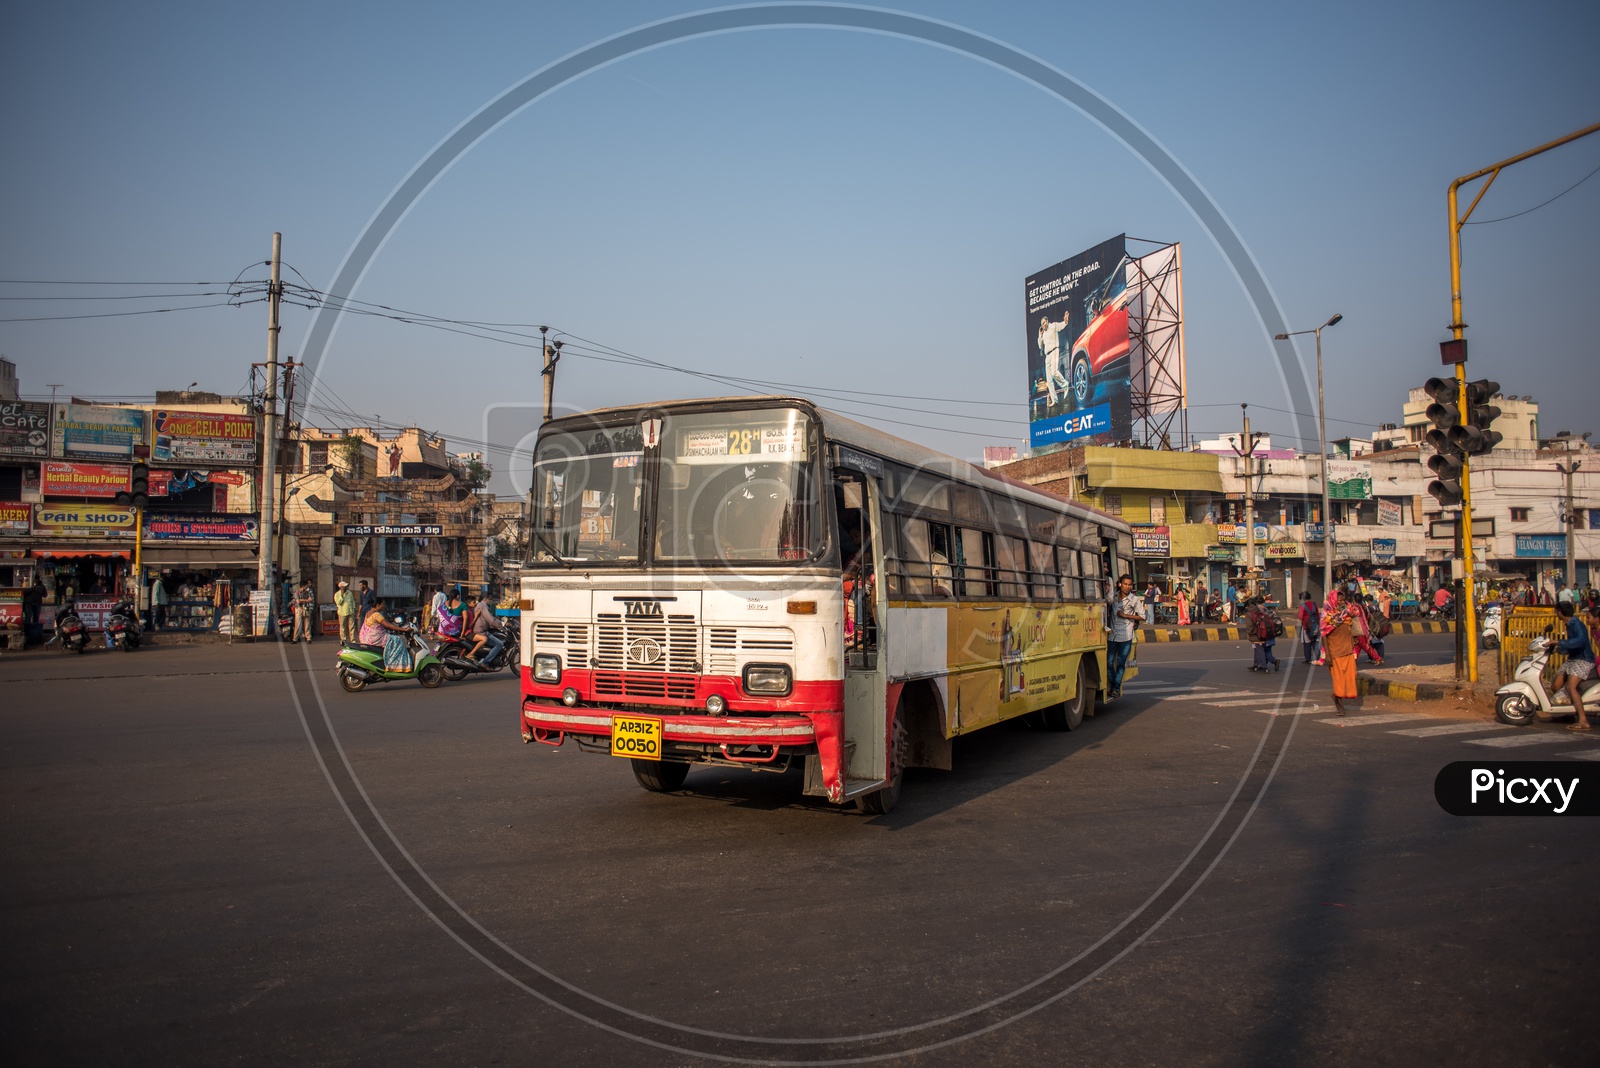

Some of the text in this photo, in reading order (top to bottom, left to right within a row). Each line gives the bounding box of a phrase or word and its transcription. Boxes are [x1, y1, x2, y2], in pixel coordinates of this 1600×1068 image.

[1029, 287, 1040, 298] GET
[1039, 277, 1063, 294] CONTROL
[1062, 274, 1072, 284] ON
[1071, 268, 1083, 280] THE
[1082, 261, 1101, 276] ROAD.
[1029, 279, 1079, 306] BECAUSE HE WON'T.
[55, 421, 142, 434] HERBAL BEAUTY PARLOUR
[195, 421, 222, 437] CELL
[224, 422, 254, 438] POINT
[1064, 414, 1093, 434] CEAT
[779, 443, 795, 452] BEAH
[47, 473, 129, 484] Herbal Beauty Parlour
[44, 513, 129, 523] PAN SHOP
[151, 523, 181, 533] BOOKS
[191, 524, 248, 534] STATIONERY
[624, 602, 663, 614] TATA
[1027, 625, 1047, 642] LUCKY
[615, 737, 657, 753] 0050
